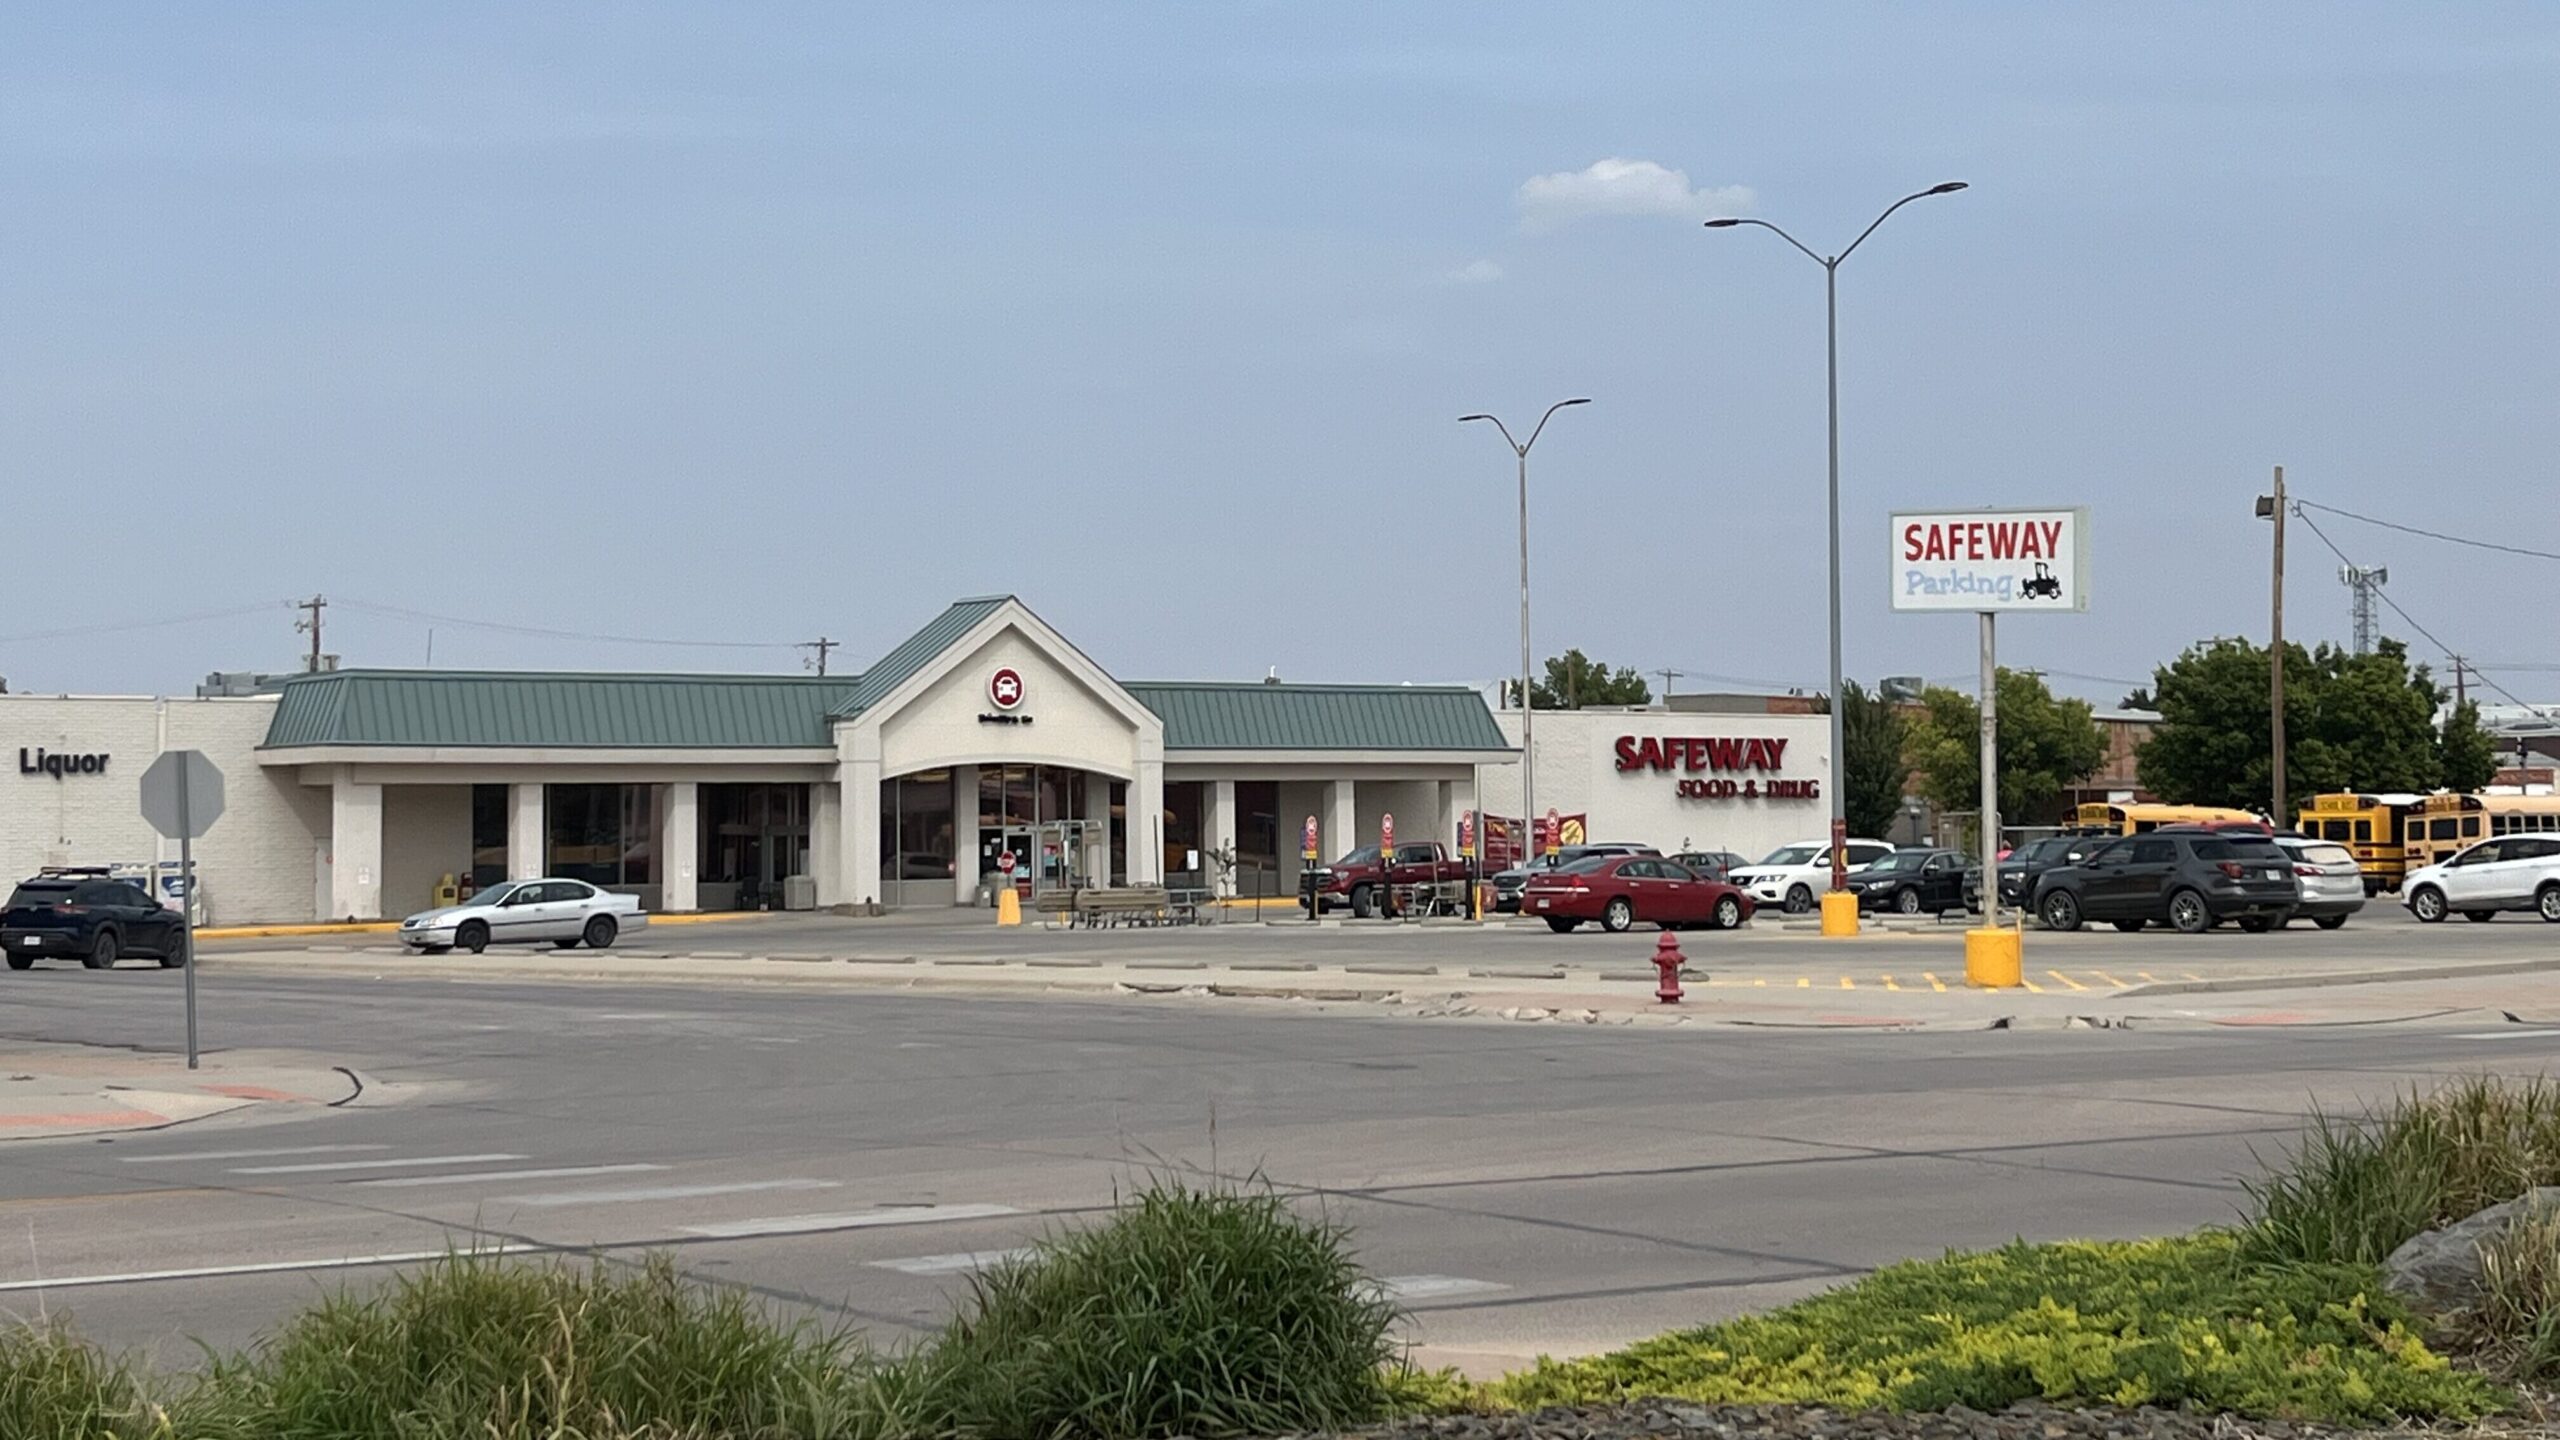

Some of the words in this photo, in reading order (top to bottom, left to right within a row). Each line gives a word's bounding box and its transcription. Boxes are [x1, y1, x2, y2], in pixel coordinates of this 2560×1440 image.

[1905, 521, 2063, 562] SAFEWAY
[1905, 567, 2013, 602] Parking
[20, 747, 110, 781] Liquor
[1615, 735, 1788, 770] SAFEWAY
[1676, 779, 1738, 798] FOOD
[1744, 779, 1759, 798] &
[1766, 780, 1820, 799] DRUG
